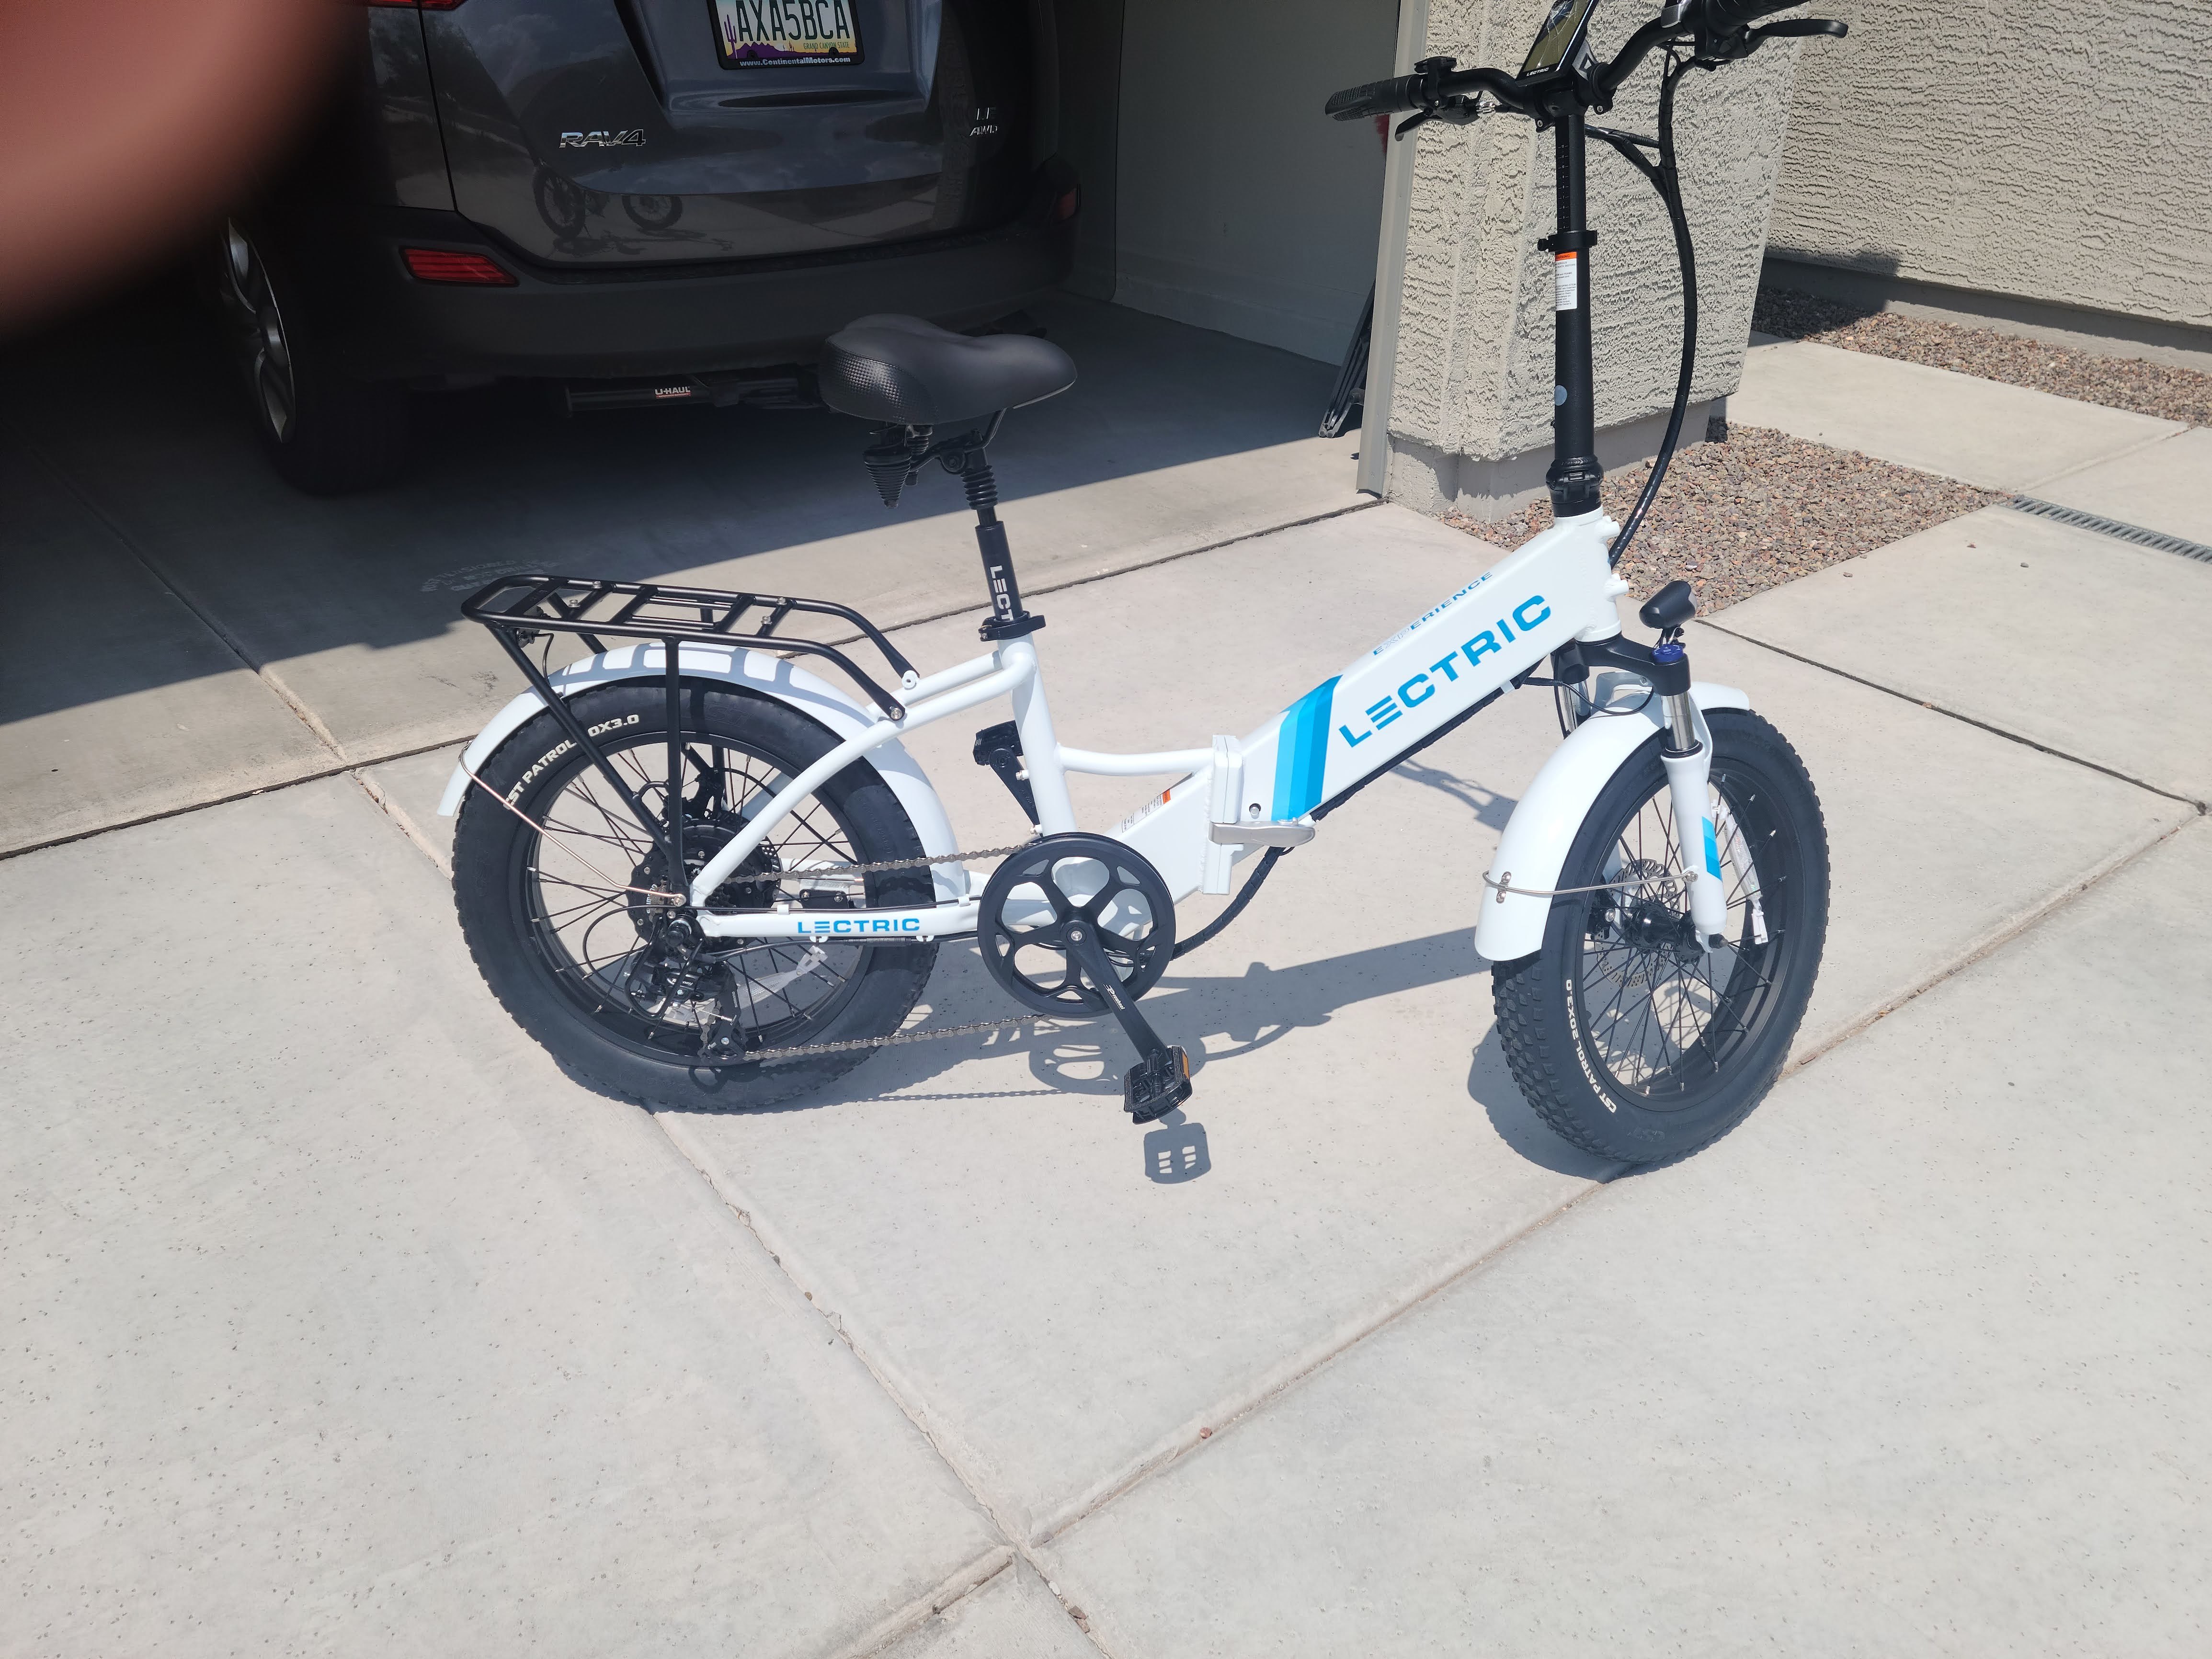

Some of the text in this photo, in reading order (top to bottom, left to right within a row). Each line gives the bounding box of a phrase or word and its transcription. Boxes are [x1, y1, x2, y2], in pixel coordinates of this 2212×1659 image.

[736, 0, 850, 41] AXA5BCA
[740, 57, 851, 67] www.ContinentalMotors.com
[1526, 68, 1550, 76] LECTRIC
[559, 129, 646, 148] RAV4
[655, 386, 690, 395] U-HAUL
[1373, 572, 1493, 656] EXPERIENCE
[1339, 595, 1551, 748] LECTRIC
[522, 739, 577, 784] PATROL
[588, 714, 639, 737] 0X3.0
[798, 918, 920, 933] LECTRIC
[1103, 984, 1126, 1011] Prowheel
[1566, 979, 1617, 1113] CST PATROL 20X3.0
